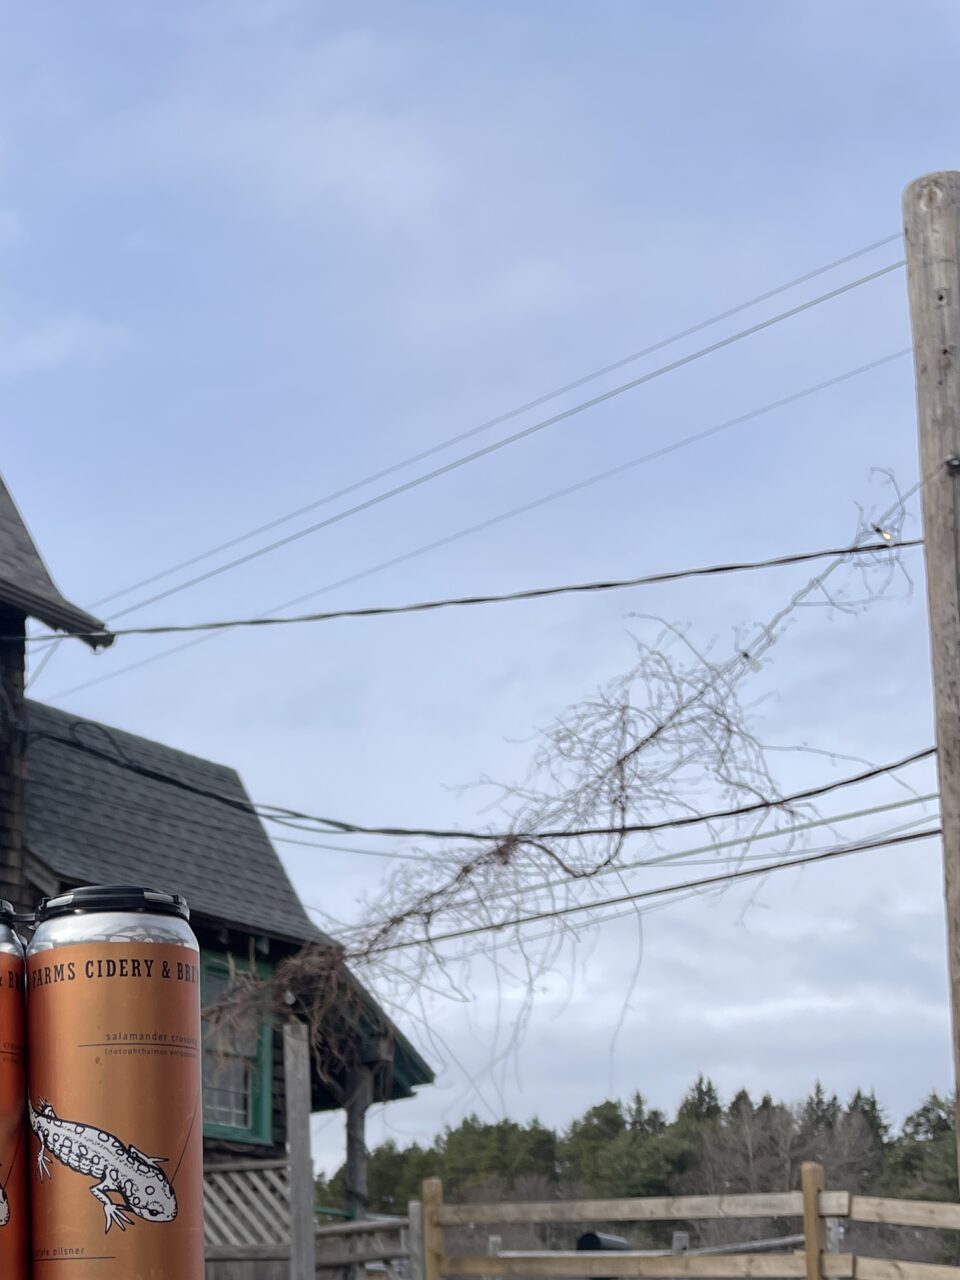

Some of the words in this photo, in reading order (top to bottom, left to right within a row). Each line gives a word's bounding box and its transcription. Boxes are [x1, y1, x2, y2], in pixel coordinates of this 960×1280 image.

[32, 962, 76, 989] FARMS
[85, 959, 154, 978] CIDERY
[161, 960, 170, 979] &
[106, 1032, 167, 1042] salamander
[52, 1247, 84, 1256] pilsner
